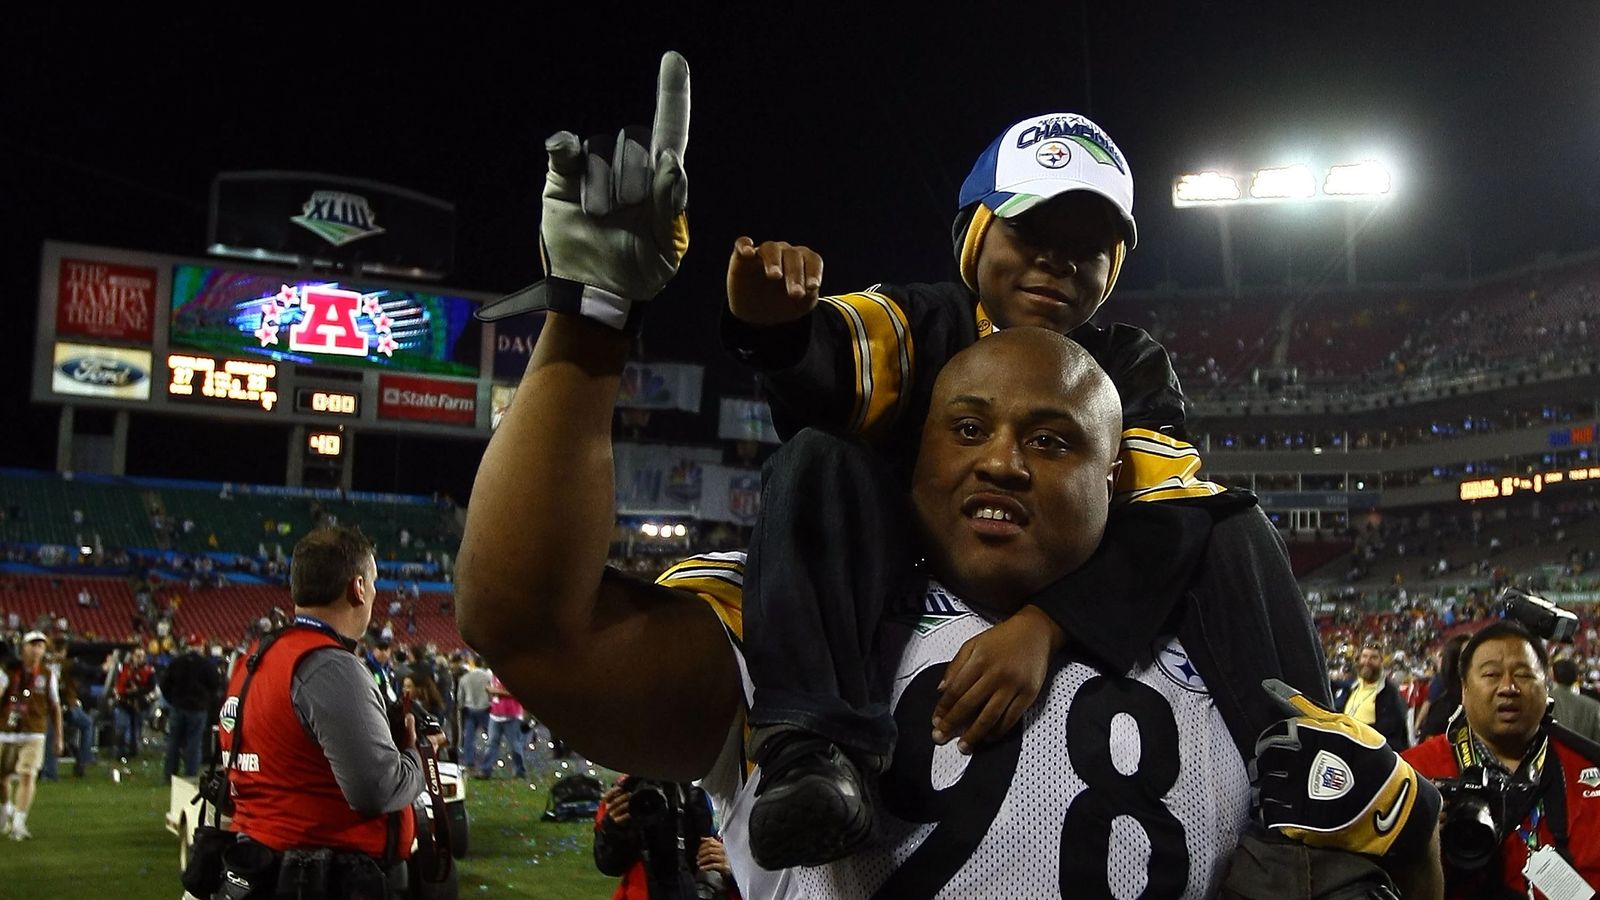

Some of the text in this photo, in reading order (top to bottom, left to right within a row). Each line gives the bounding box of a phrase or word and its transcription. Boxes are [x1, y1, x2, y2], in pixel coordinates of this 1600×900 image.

[66, 263, 107, 285] THE
[67, 281, 147, 317] TAMPA
[65, 304, 147, 330] TRIBUNE
[290, 286, 369, 356] A
[74, 359, 129, 385] Ford
[310, 434, 340, 455] 40
[427, 758, 439, 795] Canon
[869, 661, 1190, 900] 98
[1330, 769, 1346, 789] NFL
